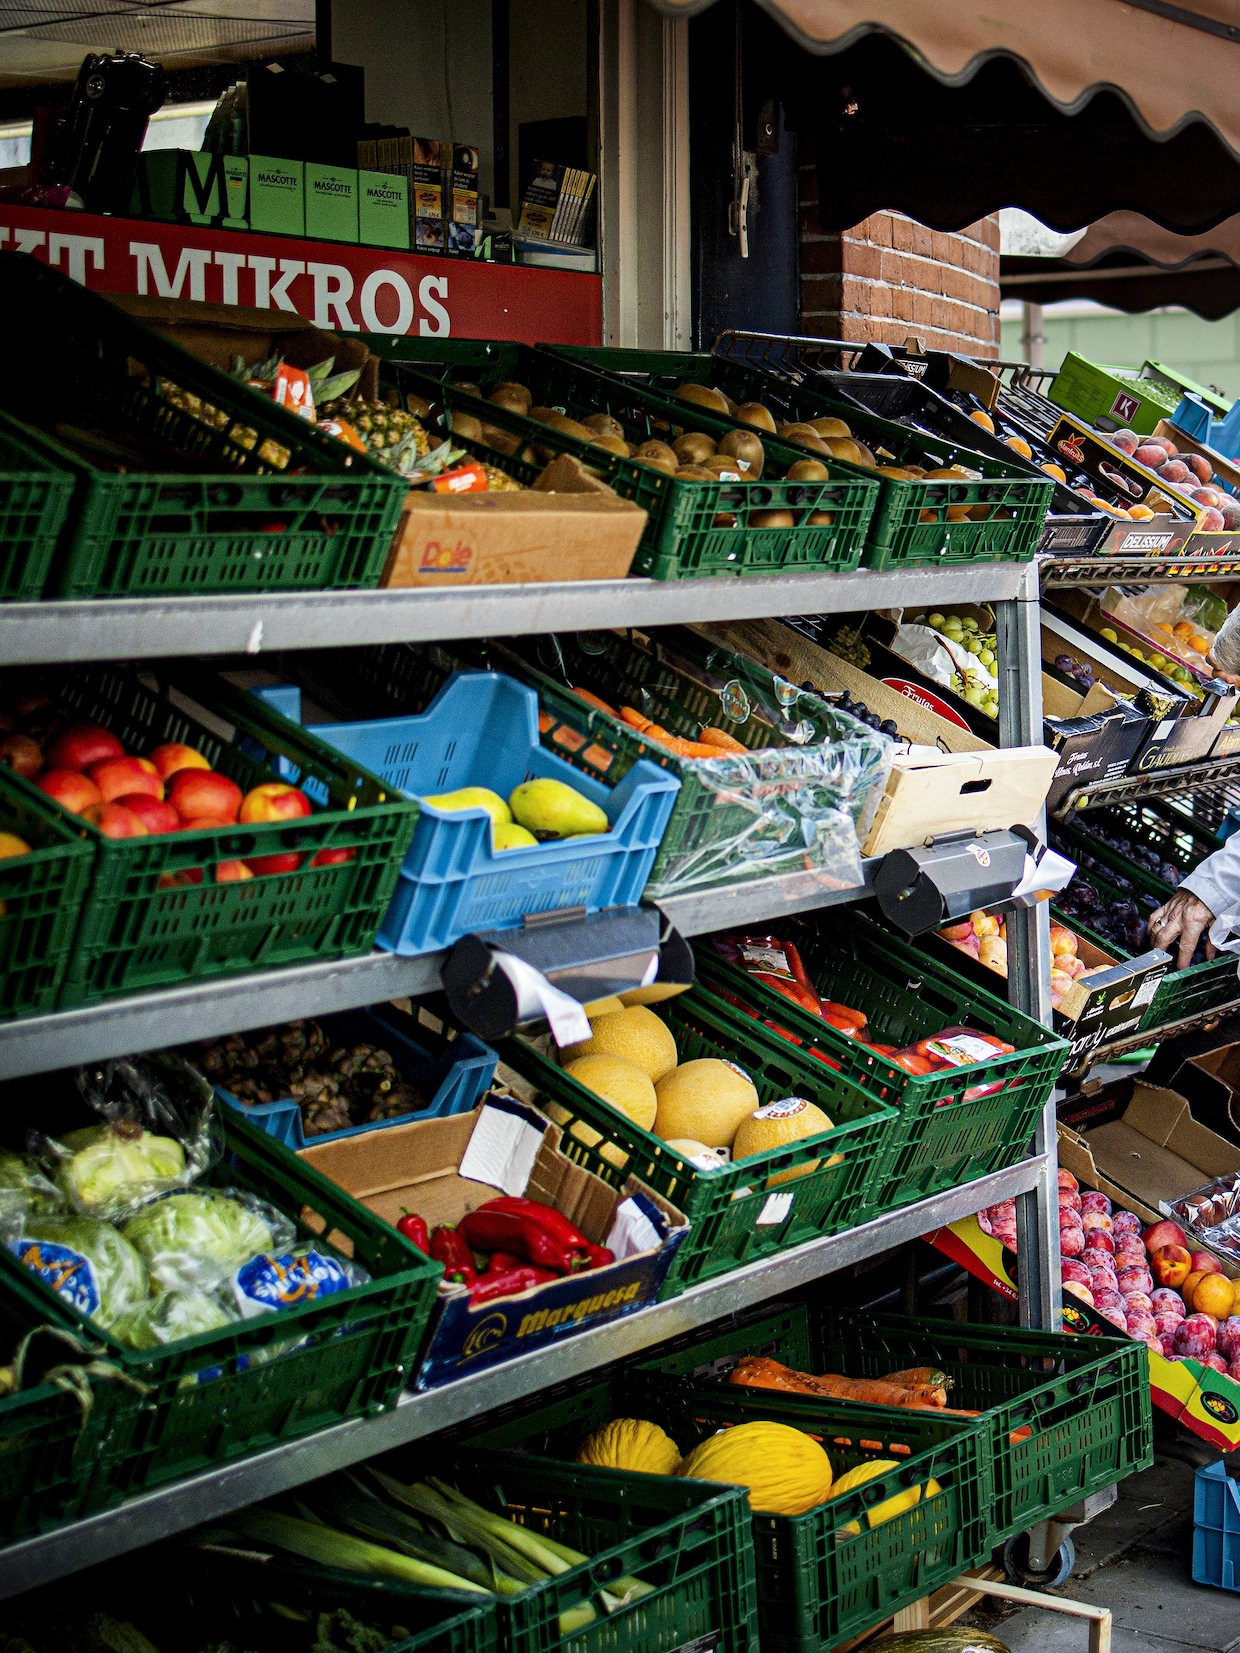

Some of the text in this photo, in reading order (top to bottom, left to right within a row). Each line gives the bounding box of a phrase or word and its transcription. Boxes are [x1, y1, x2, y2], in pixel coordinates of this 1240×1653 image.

[257, 173, 298, 186] MASCOTTE
[314, 180, 352, 194] MASCOTTE
[366, 188, 403, 201] MASCOTTE
[0, 226, 451, 338] T MIKROS
[1122, 533, 1169, 550] DELISSIUM
[421, 539, 473, 568] Dole
[901, 685, 935, 712] Frutas
[515, 1281, 642, 1339] Marquesa
